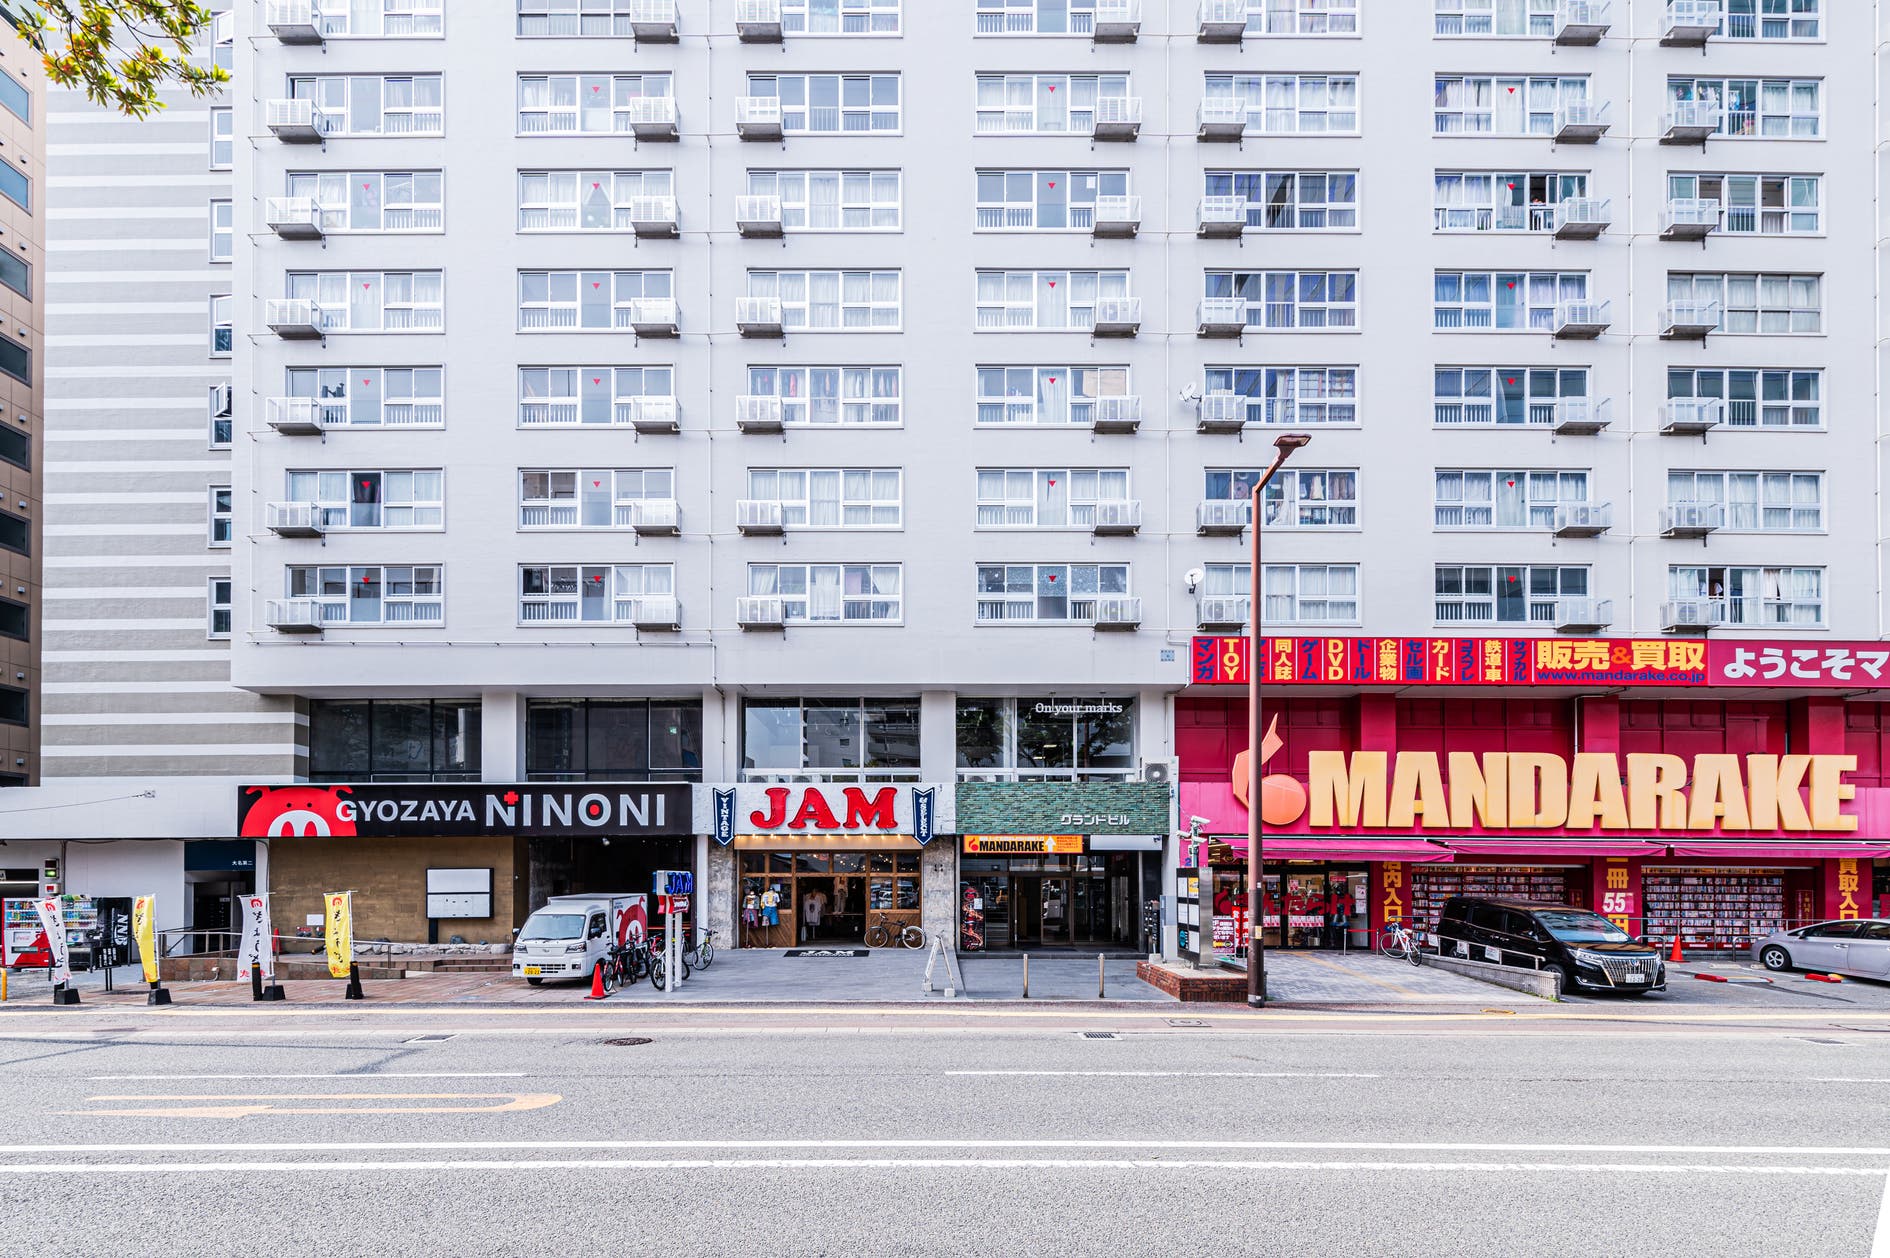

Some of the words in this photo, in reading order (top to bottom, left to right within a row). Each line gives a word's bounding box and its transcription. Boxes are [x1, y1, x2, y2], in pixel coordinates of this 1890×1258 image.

[1196, 638, 1215, 681] マンガ
[1223, 638, 1240, 681] TOY
[1274, 639, 1292, 681] 同人誌
[1301, 639, 1318, 680] ゲーム
[1327, 639, 1344, 681] DVD
[1353, 639, 1371, 680] ドール
[1379, 639, 1398, 681] 企業物
[1406, 639, 1423, 681] セル画
[1432, 639, 1450, 681] カード
[1460, 639, 1475, 681] コスプレ
[1537, 670, 1706, 683] www.mandarake.co.jp
[1723, 648, 1890, 680] ようこそマ
[1035, 702, 1053, 713] On
[1053, 704, 1083, 716] your
[1085, 702, 1123, 714] marks
[335, 799, 477, 822] GYOZAYA
[485, 791, 666, 827] NINONI
[749, 787, 899, 830] JAM
[1309, 750, 1858, 831] MANDARAKE
[720, 797, 730, 838] VINTAGE
[1060, 814, 1130, 826] グランドビル
[979, 841, 1045, 852] MANDARAKE
[664, 871, 694, 895] JAM
